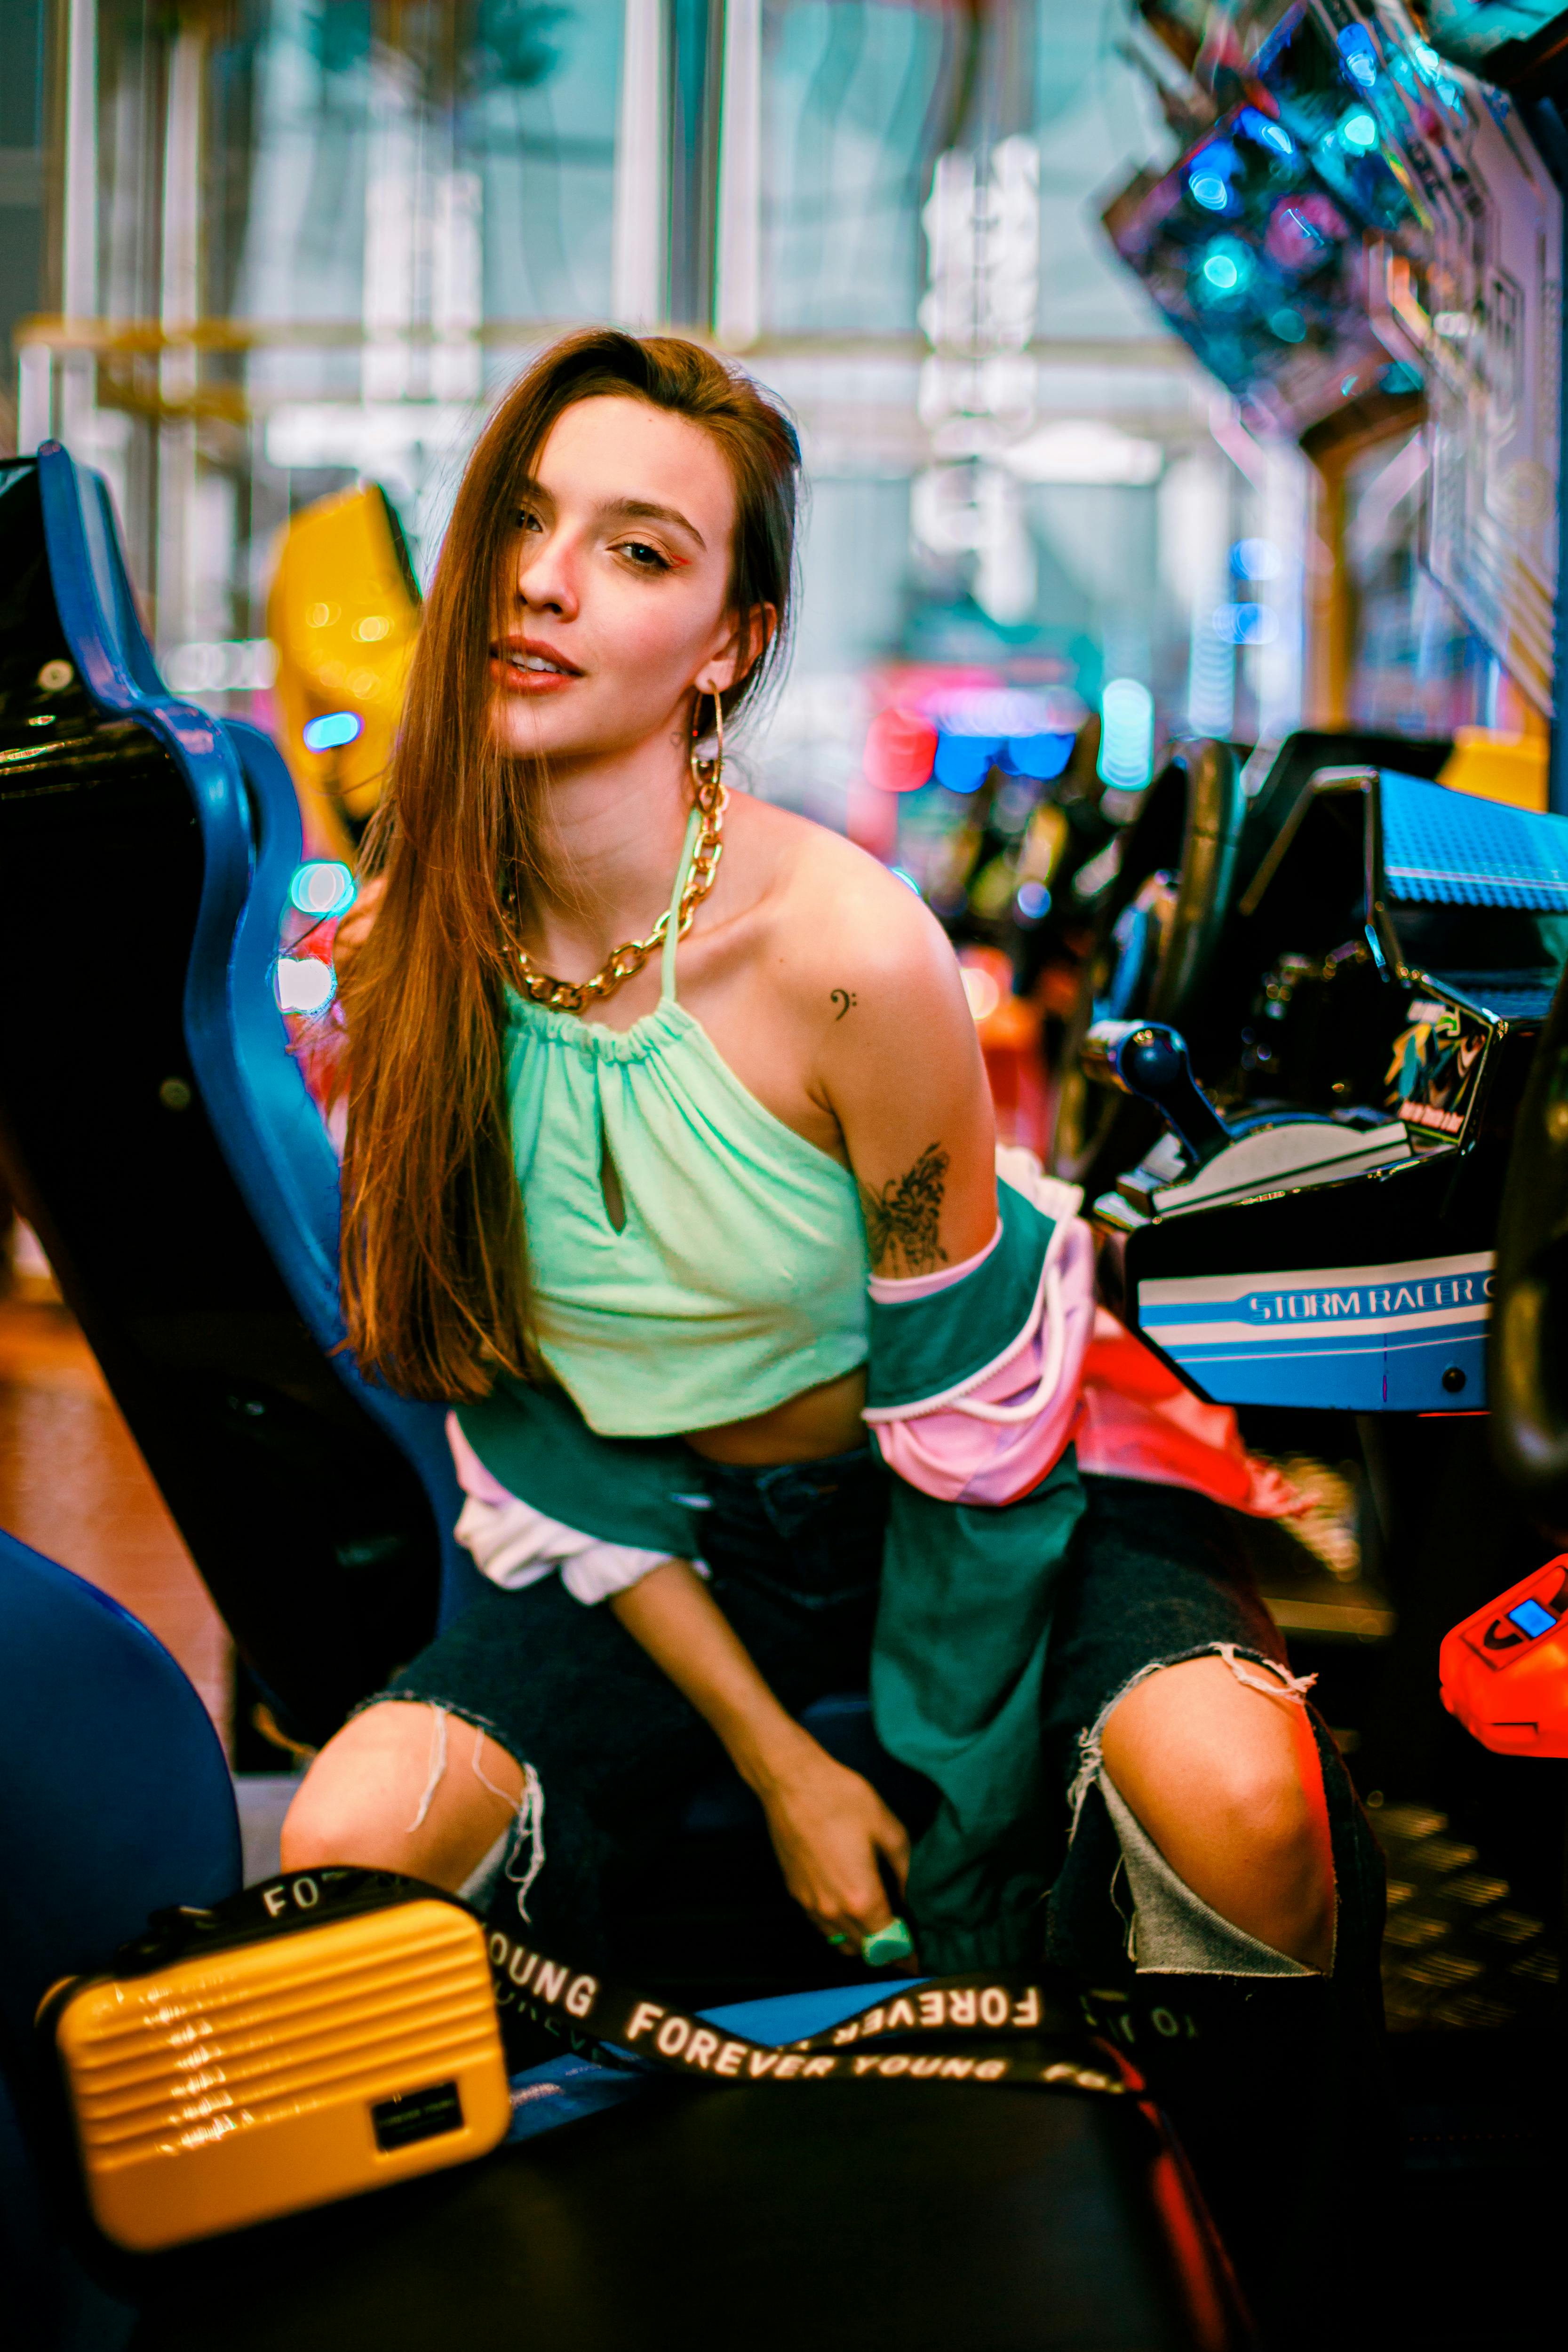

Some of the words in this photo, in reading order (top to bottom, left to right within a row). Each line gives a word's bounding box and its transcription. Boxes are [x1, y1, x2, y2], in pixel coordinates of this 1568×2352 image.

[1250, 1291, 1361, 1320] STORM
[1369, 1278, 1474, 1314] RACER
[488, 1931, 597, 2019] OUNG
[625, 2001, 836, 2080] FOREVER
[853, 2055, 1007, 2081] YOUNG
